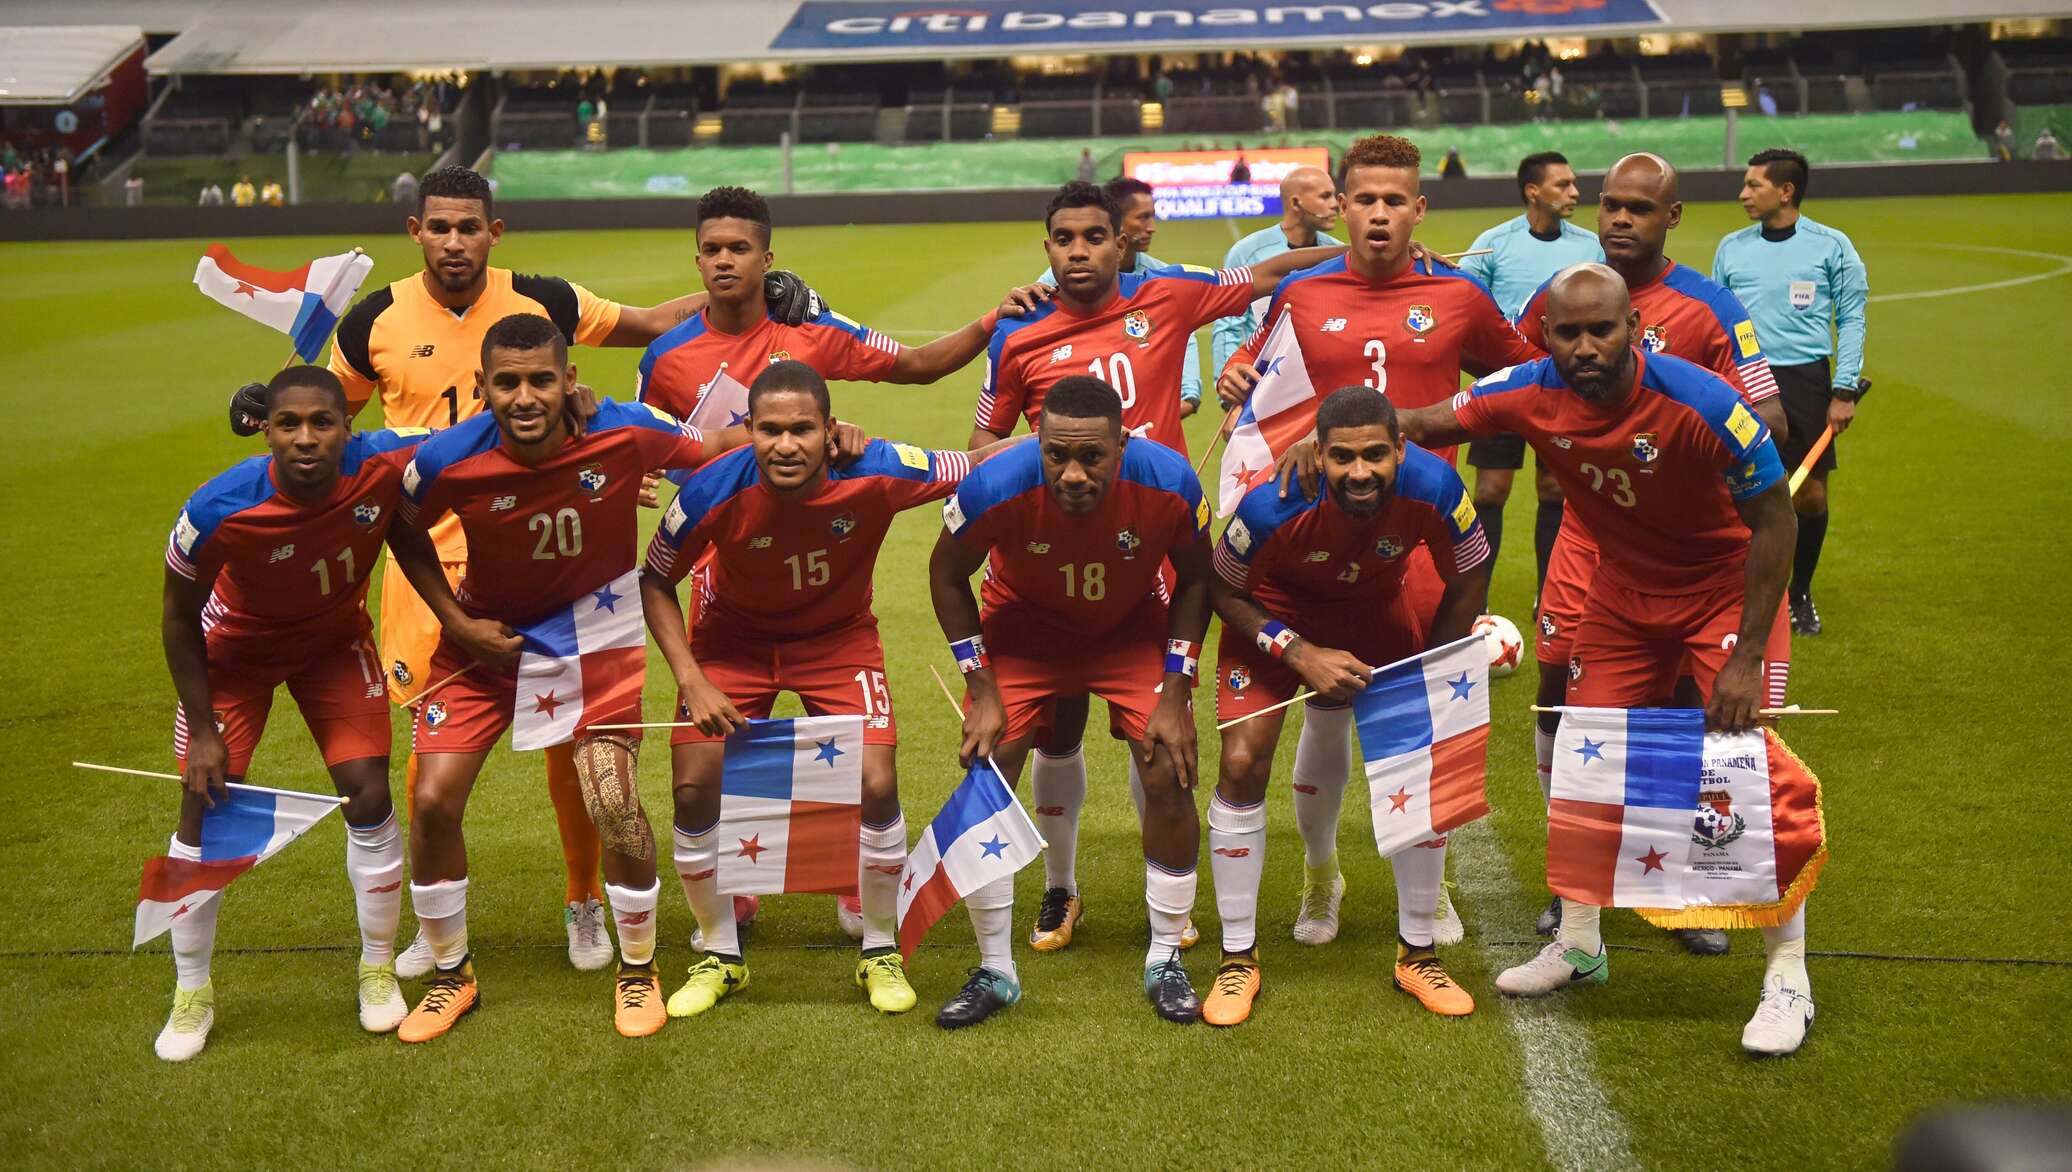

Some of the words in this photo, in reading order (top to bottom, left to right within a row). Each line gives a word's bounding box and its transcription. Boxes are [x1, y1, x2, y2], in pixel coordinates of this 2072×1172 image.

[1154, 197, 1265, 219] QUALIFIERS
[1363, 339, 1388, 395] 3
[1580, 463, 1637, 508] 23
[528, 507, 583, 560] 20
[310, 546, 355, 595] 11
[783, 549, 831, 590] 15
[1058, 562, 1106, 601] 18
[854, 670, 890, 715] 15
[1700, 769, 1716, 777] DE
[1700, 776, 1731, 785] TBOL
[1711, 754, 1757, 771] PANAMEÑA
